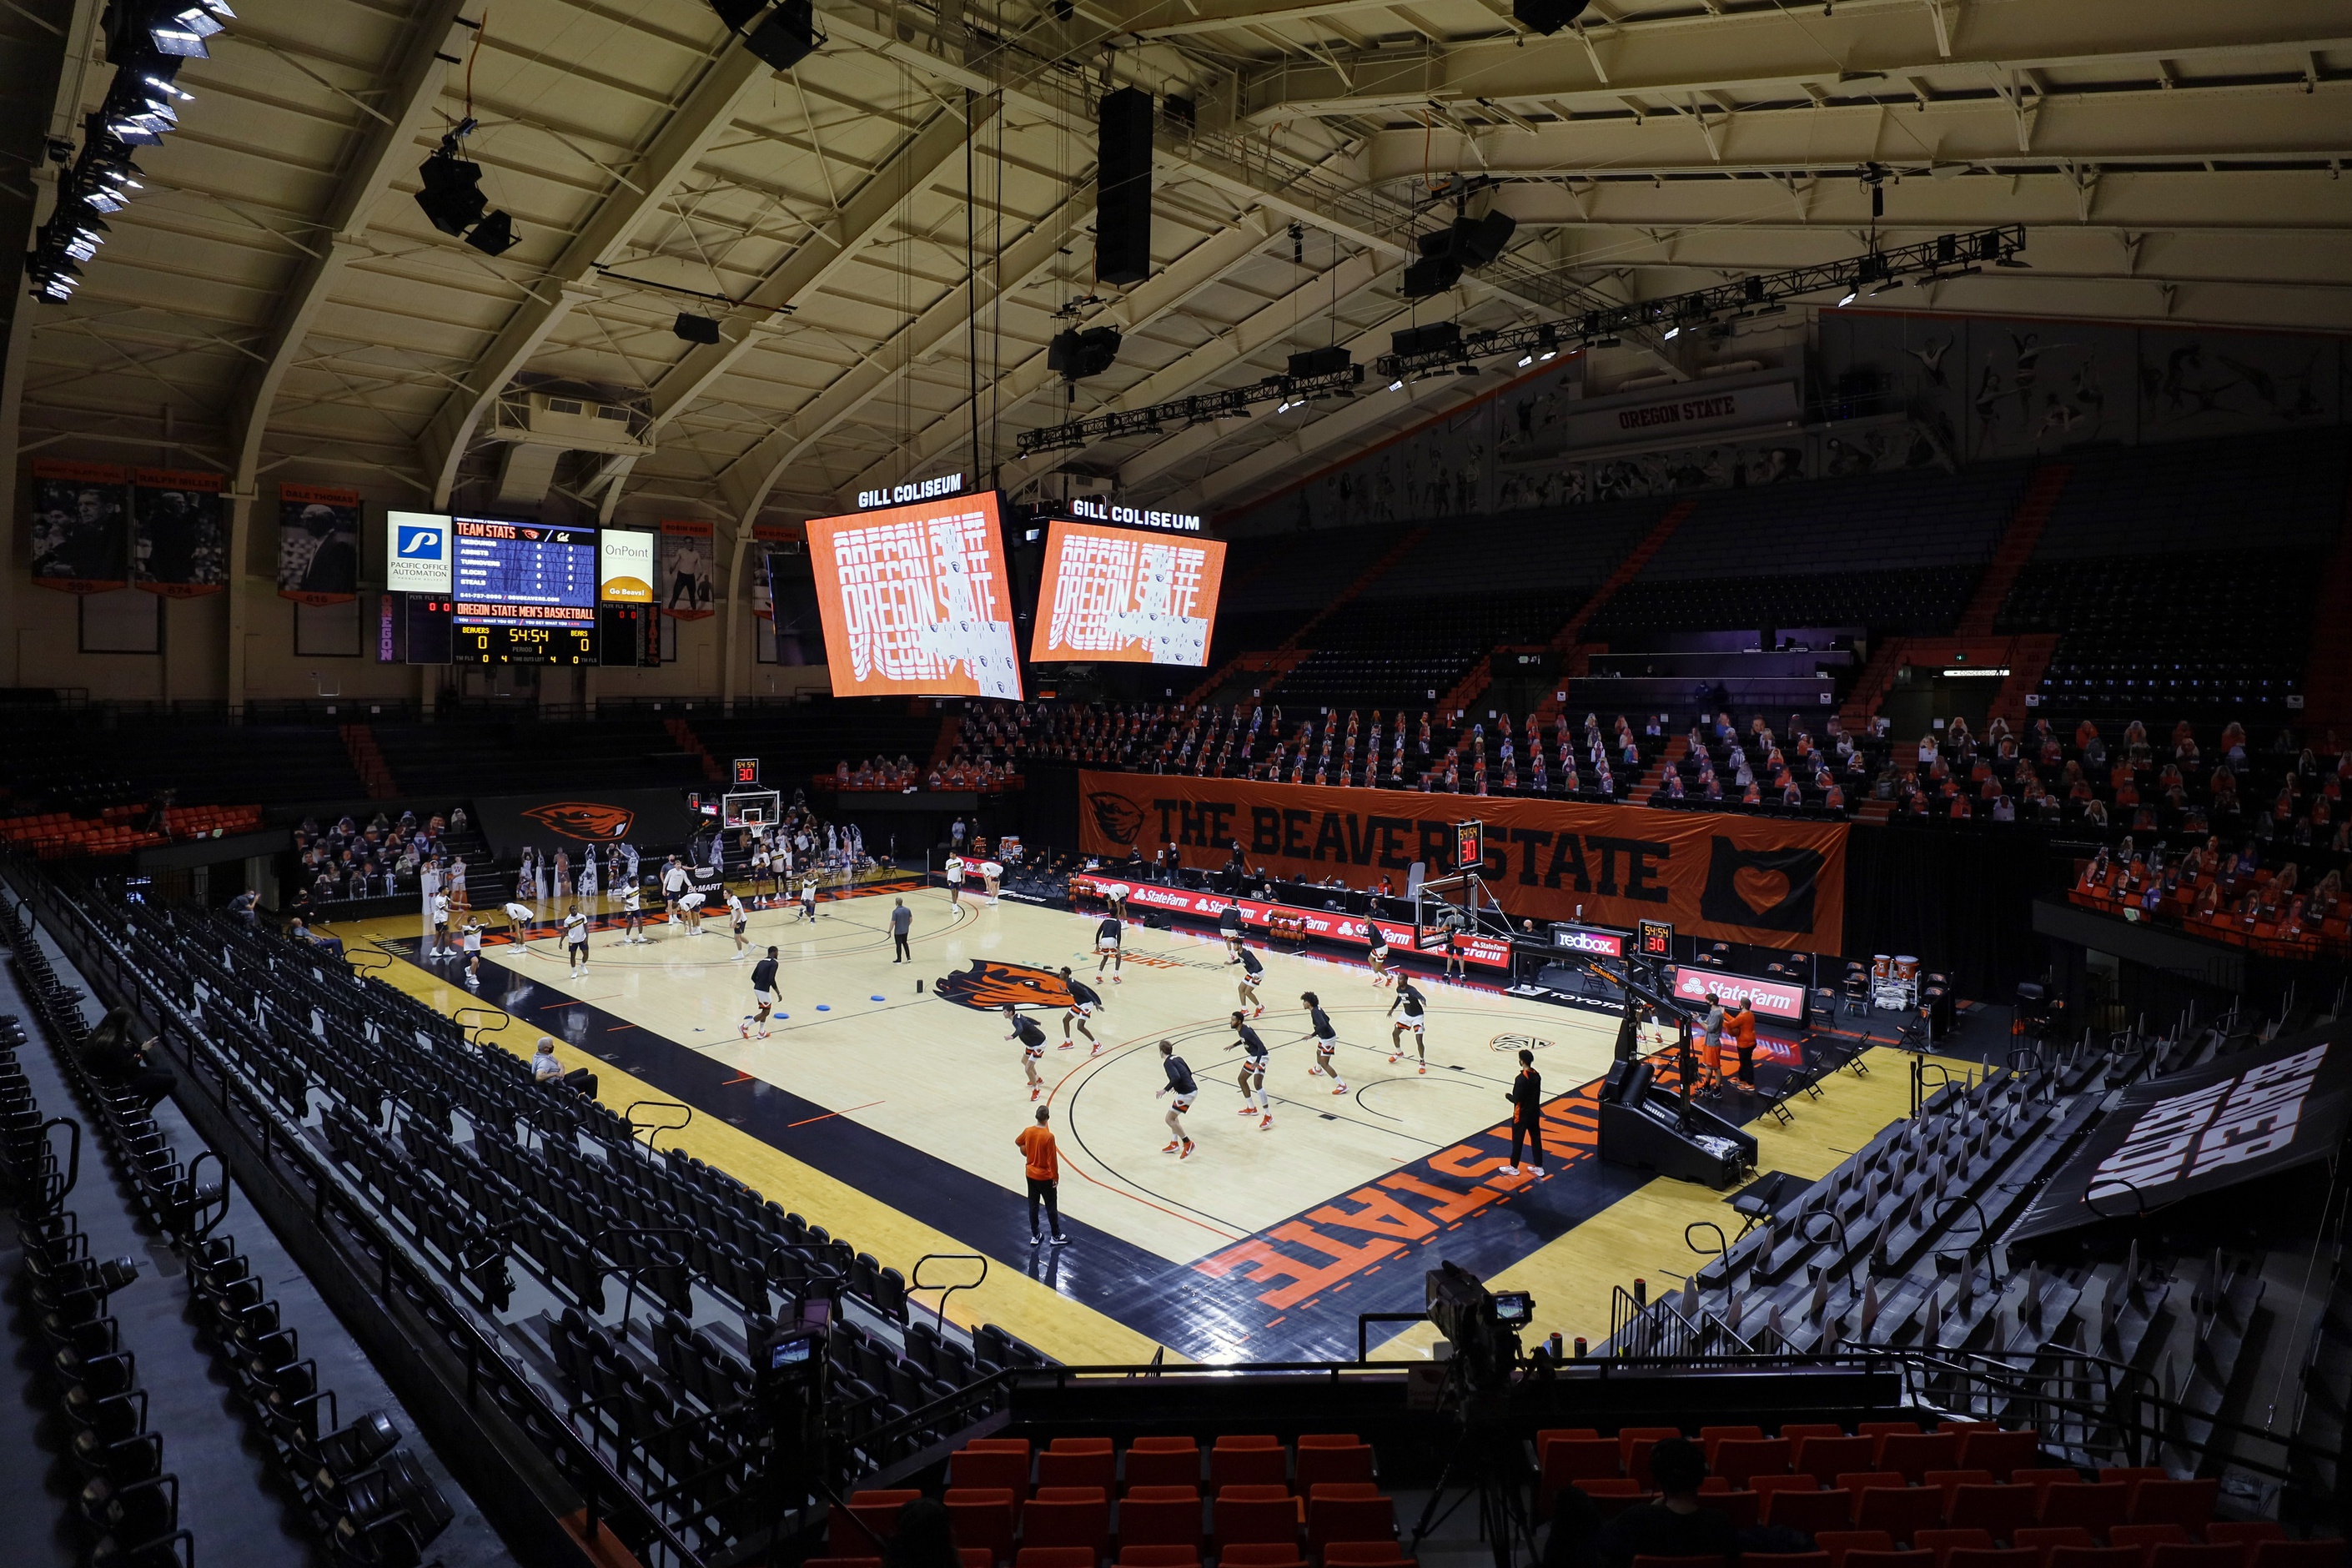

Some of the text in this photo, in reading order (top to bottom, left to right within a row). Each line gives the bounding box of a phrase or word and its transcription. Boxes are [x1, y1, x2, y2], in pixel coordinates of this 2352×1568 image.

[1619, 395, 1736, 430] OREGON STATE
[139, 475, 219, 488] RALPH MILLER
[286, 490, 354, 503] DALE THOMAS
[858, 473, 962, 508] GILL COLISEUM
[1073, 500, 1200, 530] GILL COLISEUM
[456, 522, 515, 539] TEAM STATS
[606, 545, 648, 558] OnPoint
[391, 561, 420, 570] PACIFIC
[393, 569, 447, 577] AUTOMATION
[1053, 575, 1132, 615] OREGON
[457, 603, 595, 620] OREGON STATE MEN'S BASKETBALL
[842, 576, 937, 635] OREGON
[380, 595, 393, 661] OREGON
[509, 629, 549, 642] 54:54
[478, 636, 590, 651] 0 0
[739, 768, 752, 781] 30
[1153, 798, 1670, 903] THE BEAVER STATE
[1461, 839, 1477, 862] 30
[1649, 937, 1666, 952] 30
[1589, 962, 1618, 983] Schelde
[1550, 992, 1626, 1010] TOYOTA
[1192, 1143, 1536, 1310] STATE
